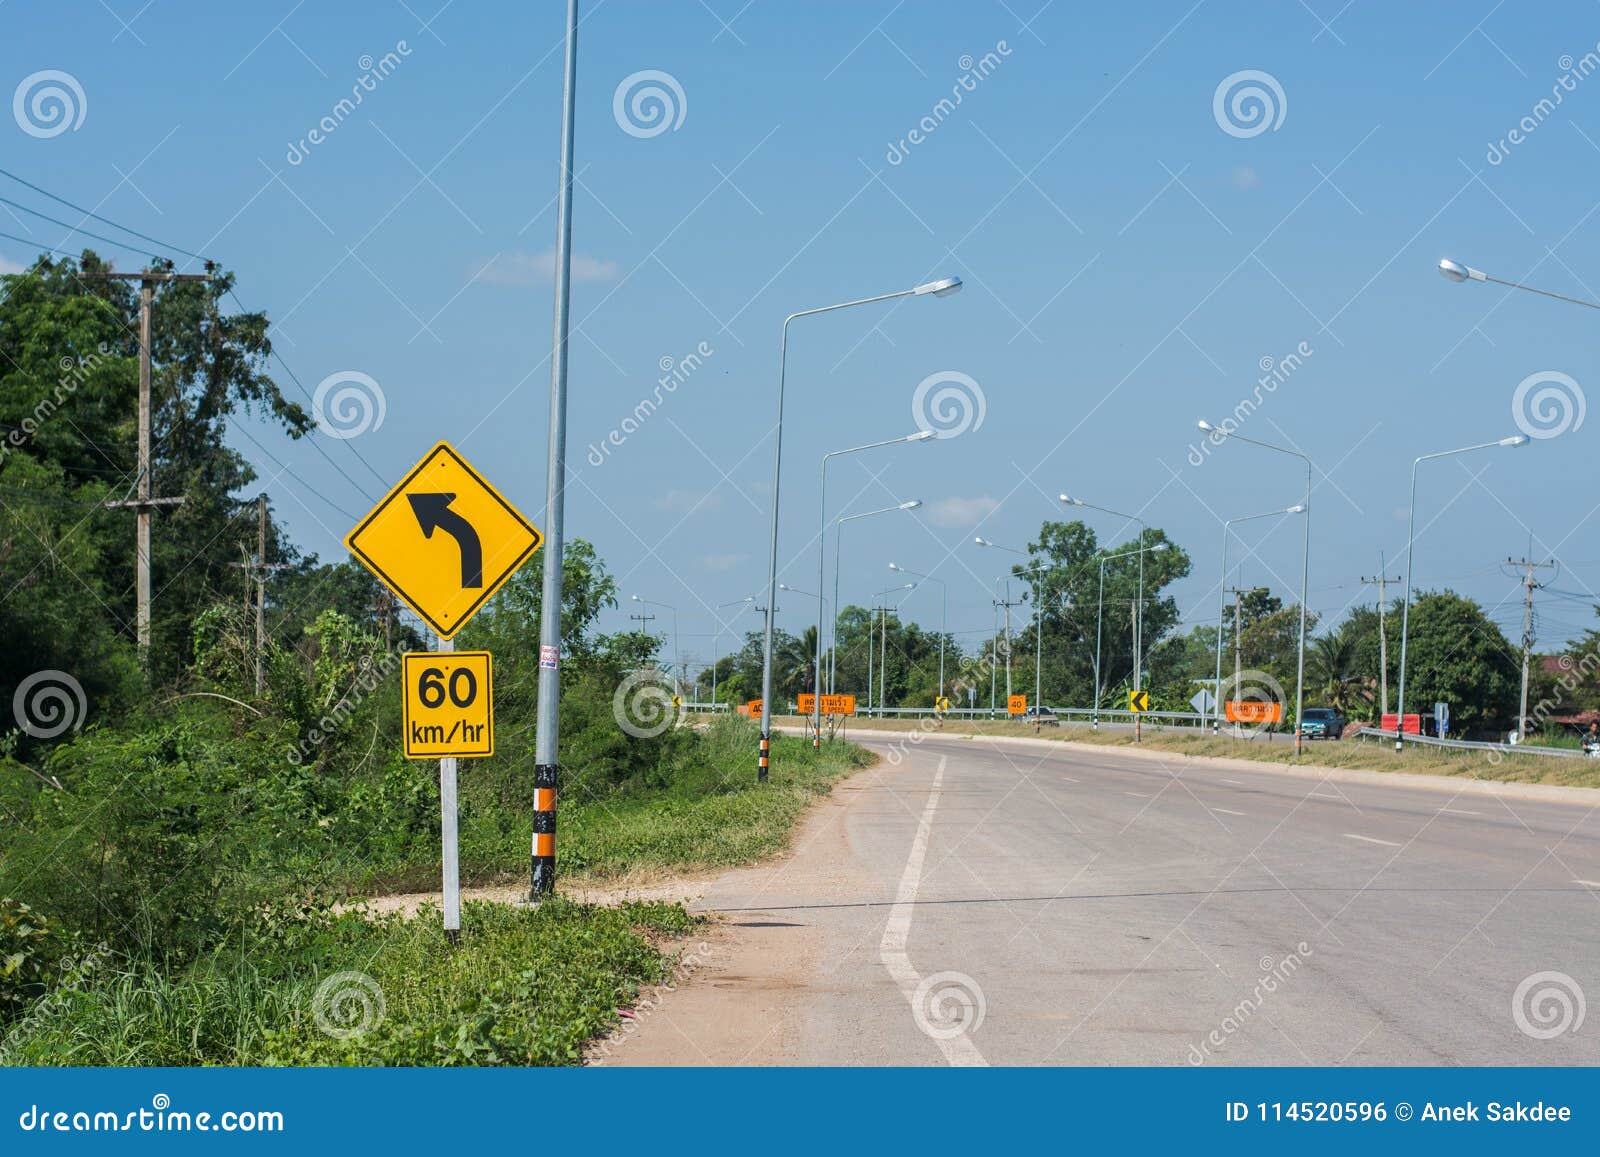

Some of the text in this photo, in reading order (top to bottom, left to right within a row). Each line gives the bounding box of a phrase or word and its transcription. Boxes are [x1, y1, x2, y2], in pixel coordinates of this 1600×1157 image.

[418, 667, 477, 708] 60
[1011, 701, 1022, 709] 40
[412, 720, 484, 744] km/hr
